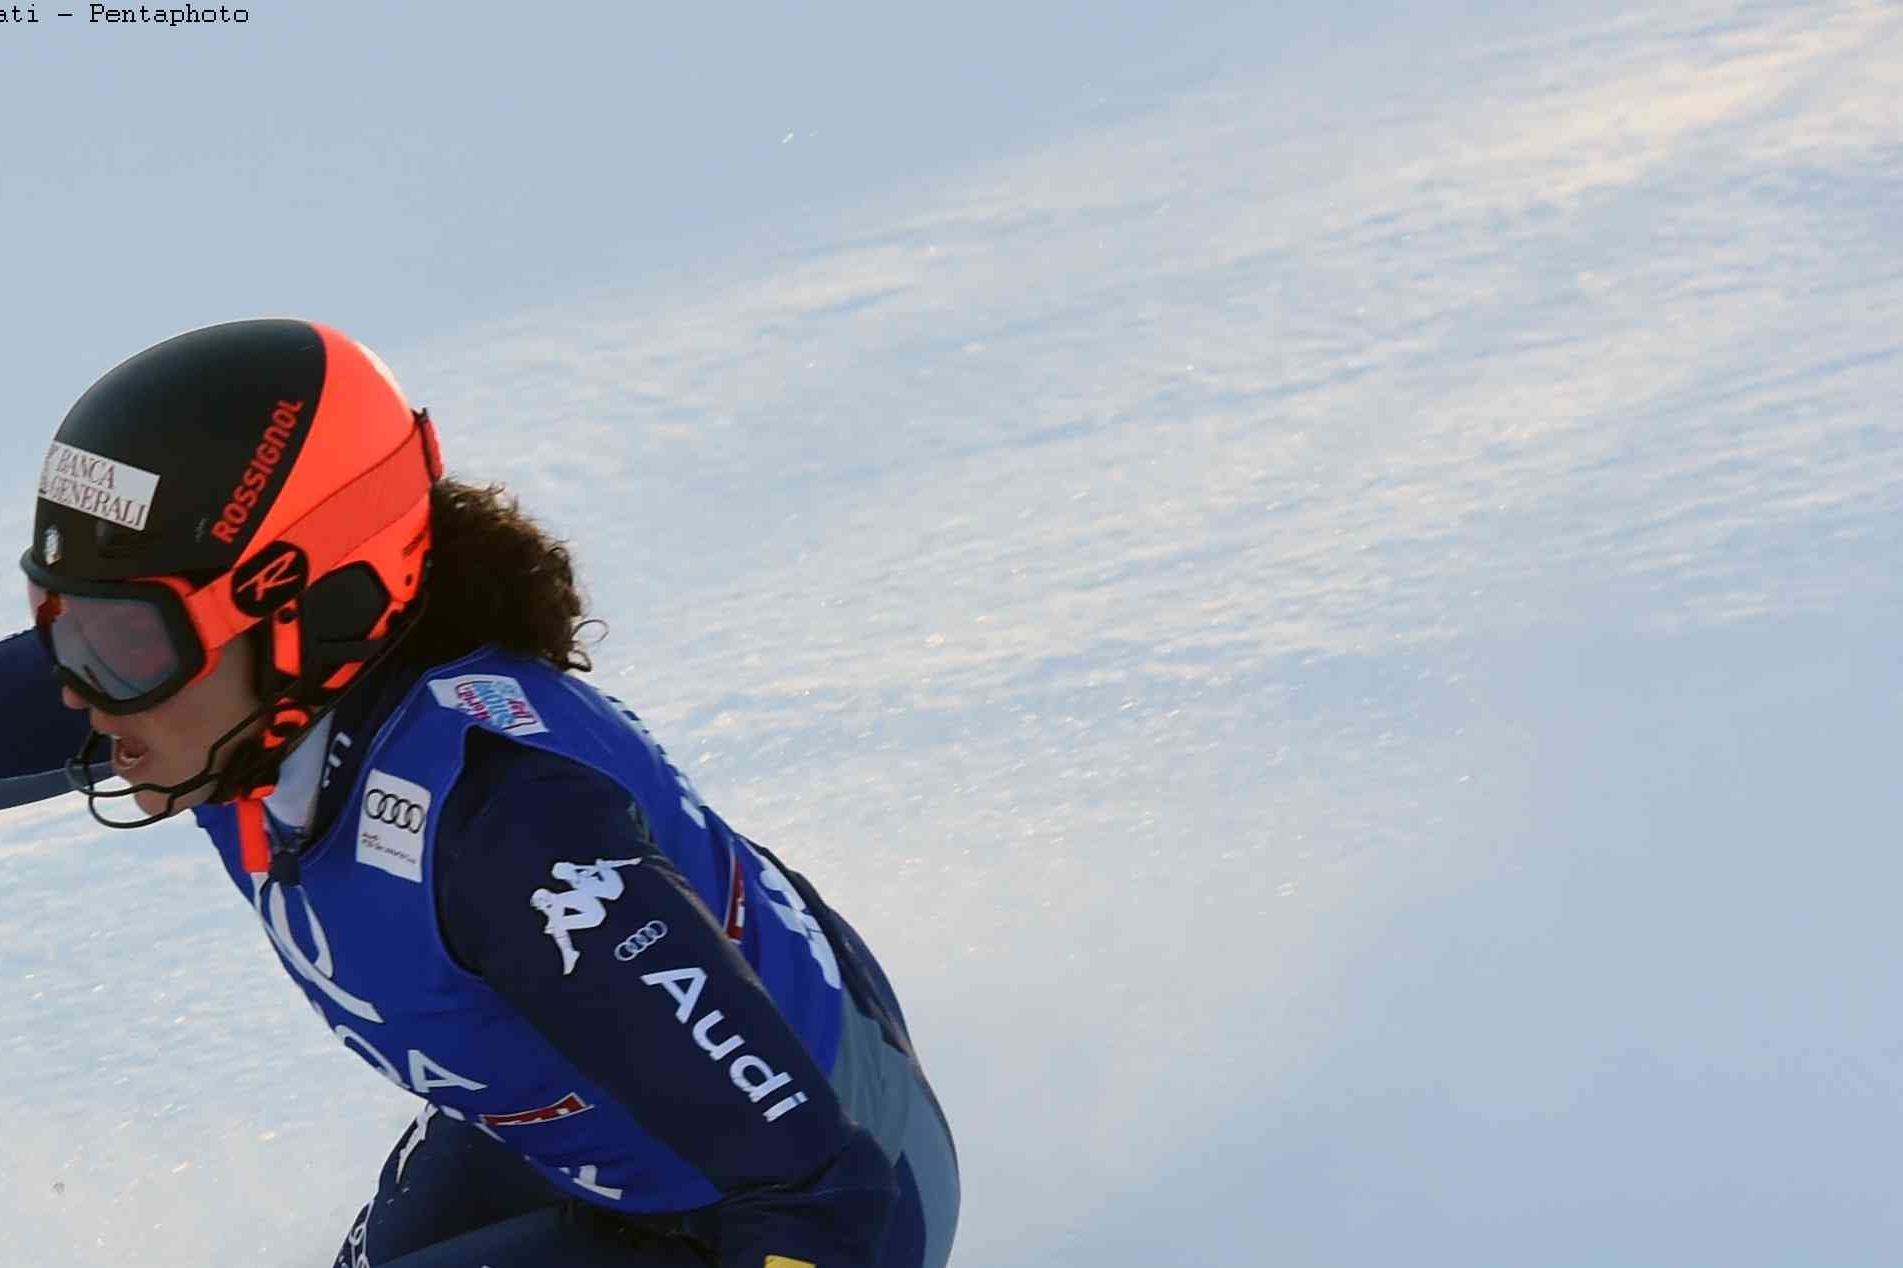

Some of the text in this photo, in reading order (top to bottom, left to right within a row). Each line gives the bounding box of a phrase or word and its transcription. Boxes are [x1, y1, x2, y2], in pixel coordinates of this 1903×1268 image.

[48, 475, 147, 527] GENERALI
[56, 448, 115, 491] BANCA
[210, 399, 304, 544] ROSSIGNOL
[640, 966, 810, 1123] Audi
